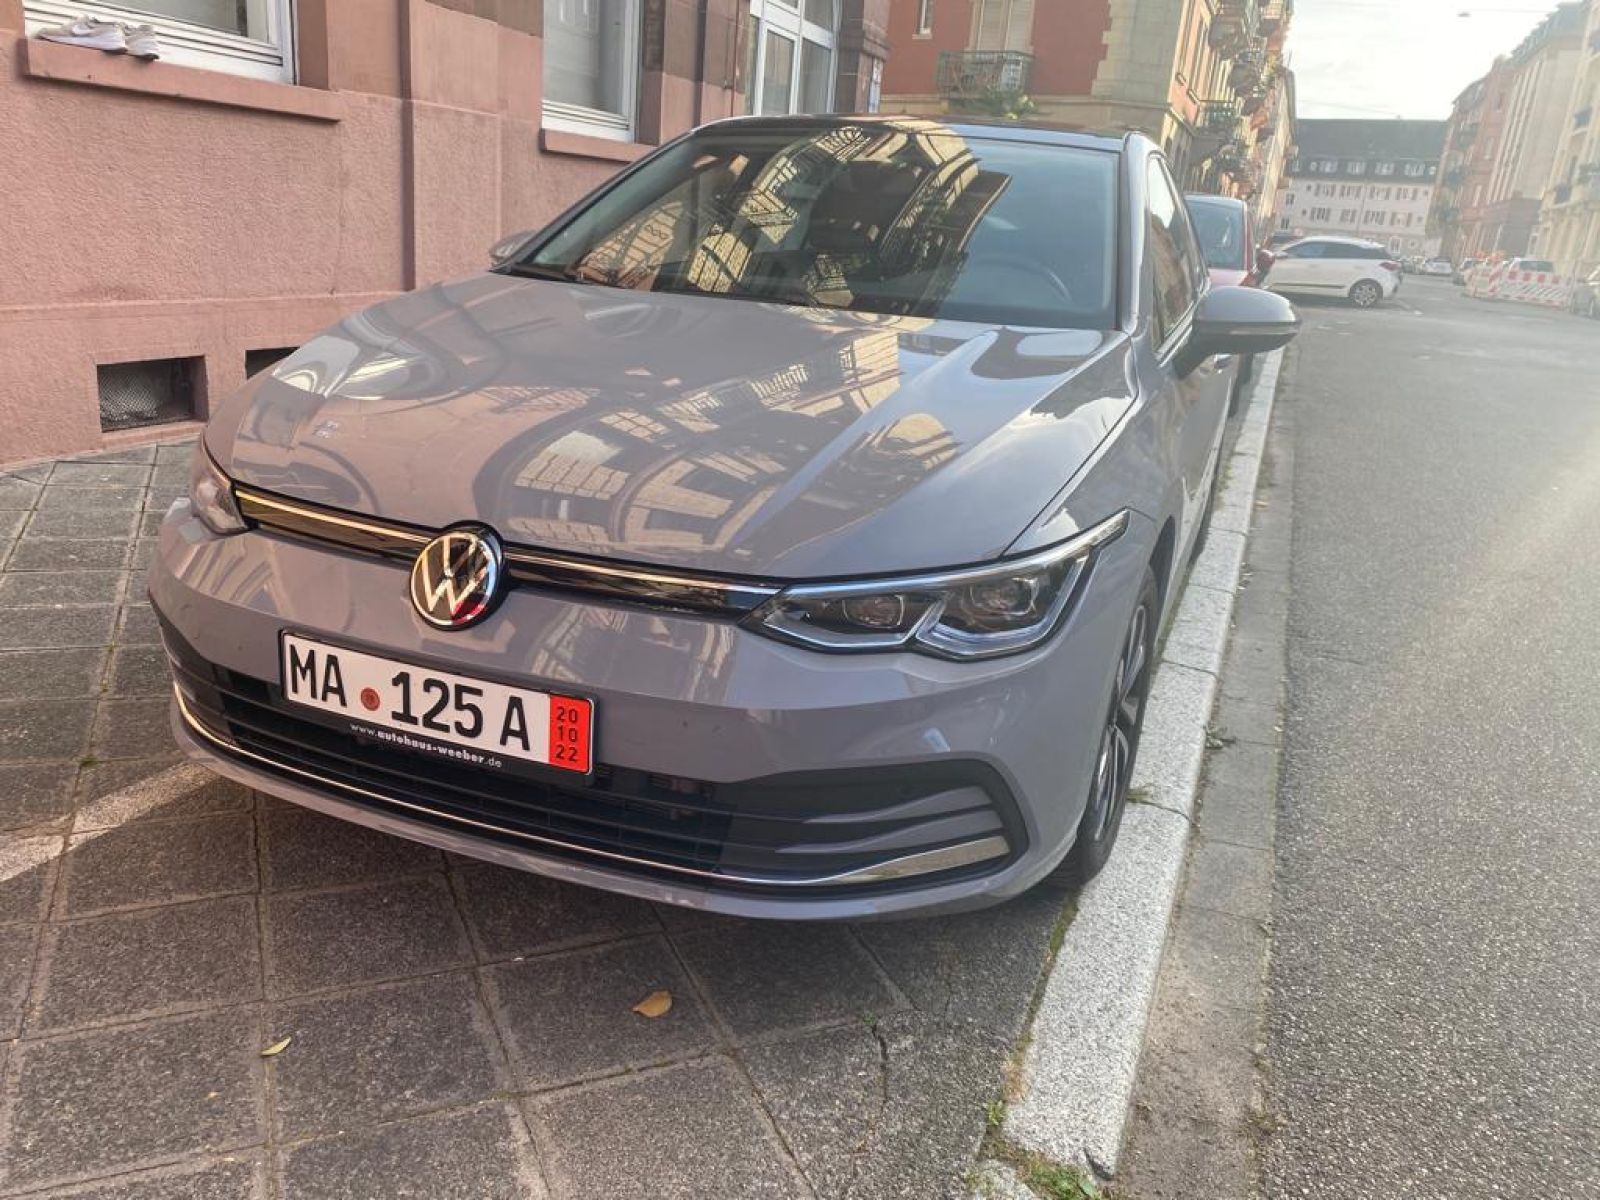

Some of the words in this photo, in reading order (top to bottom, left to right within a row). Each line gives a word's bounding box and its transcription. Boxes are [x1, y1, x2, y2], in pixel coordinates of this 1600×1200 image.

[411, 533, 497, 625] VW
[289, 644, 347, 708] MA
[391, 671, 483, 738] 125
[499, 695, 530, 751] A
[556, 706, 577, 723] 20
[350, 723, 503, 768] www.autohaus-weeber.de
[558, 725, 577, 742] 10
[555, 744, 577, 762] 22
